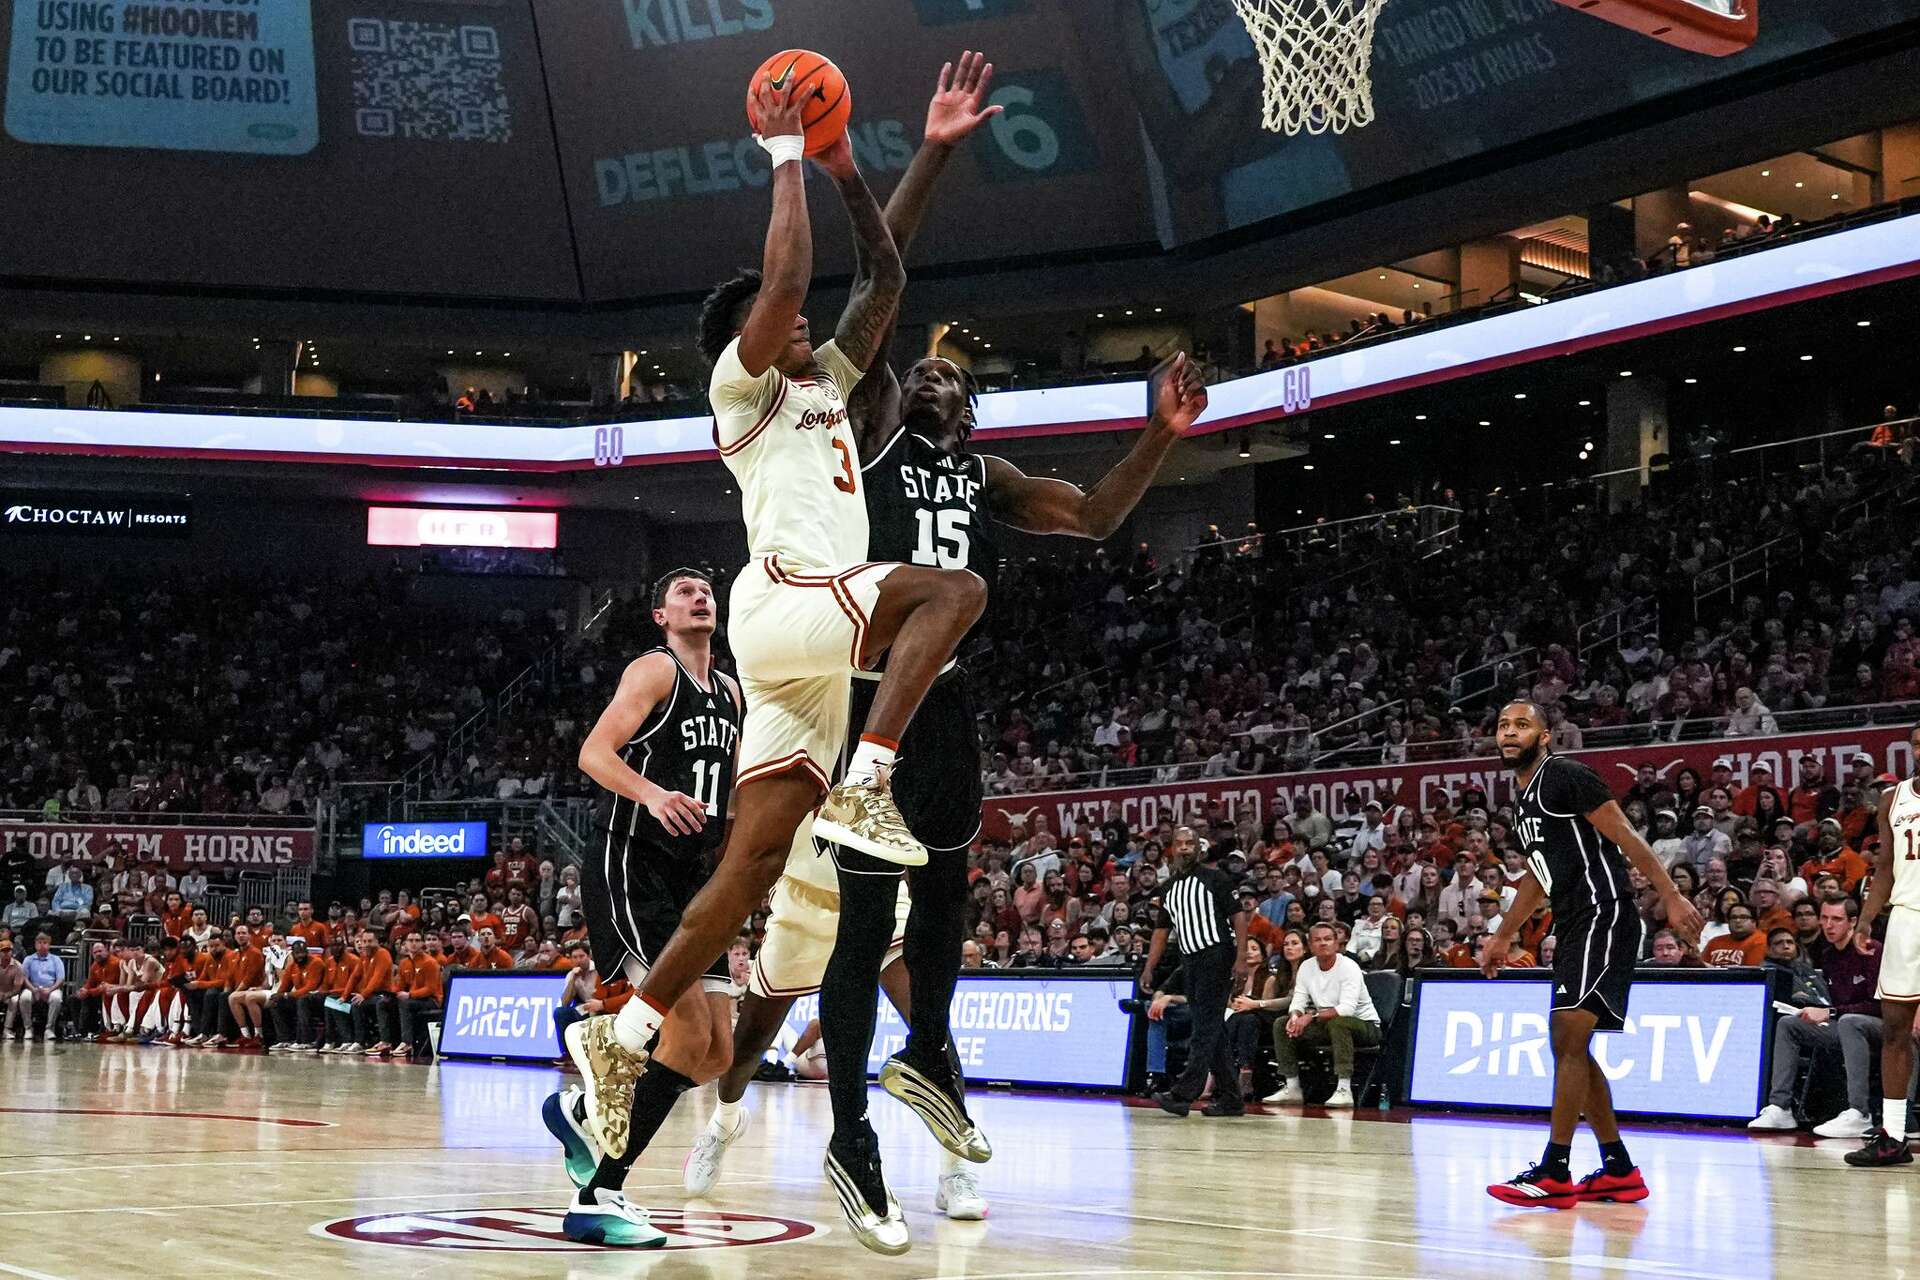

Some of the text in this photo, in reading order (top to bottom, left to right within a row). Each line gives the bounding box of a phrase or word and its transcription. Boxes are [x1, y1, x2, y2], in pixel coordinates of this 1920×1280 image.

[37, 2, 259, 41] USING #HOOKEM
[623, 0, 774, 49] KILLS
[35, 36, 285, 74] TO BE FEATURED ON
[32, 68, 290, 105] OUR SOCIAL BOARD!
[988, 85, 1060, 169] 6
[1283, 366, 1311, 413] GO
[595, 427, 623, 466] GO
[832, 436, 857, 495] 3
[901, 465, 980, 513] STATE
[16, 505, 187, 525] CHOCTAW RESORTS
[911, 508, 970, 570] 15
[681, 715, 738, 756] STATE
[692, 759, 721, 817] 11
[183, 835, 295, 865] HORNS
[377, 826, 465, 854] indeed
[1444, 1010, 1733, 1083] DIRCTV
